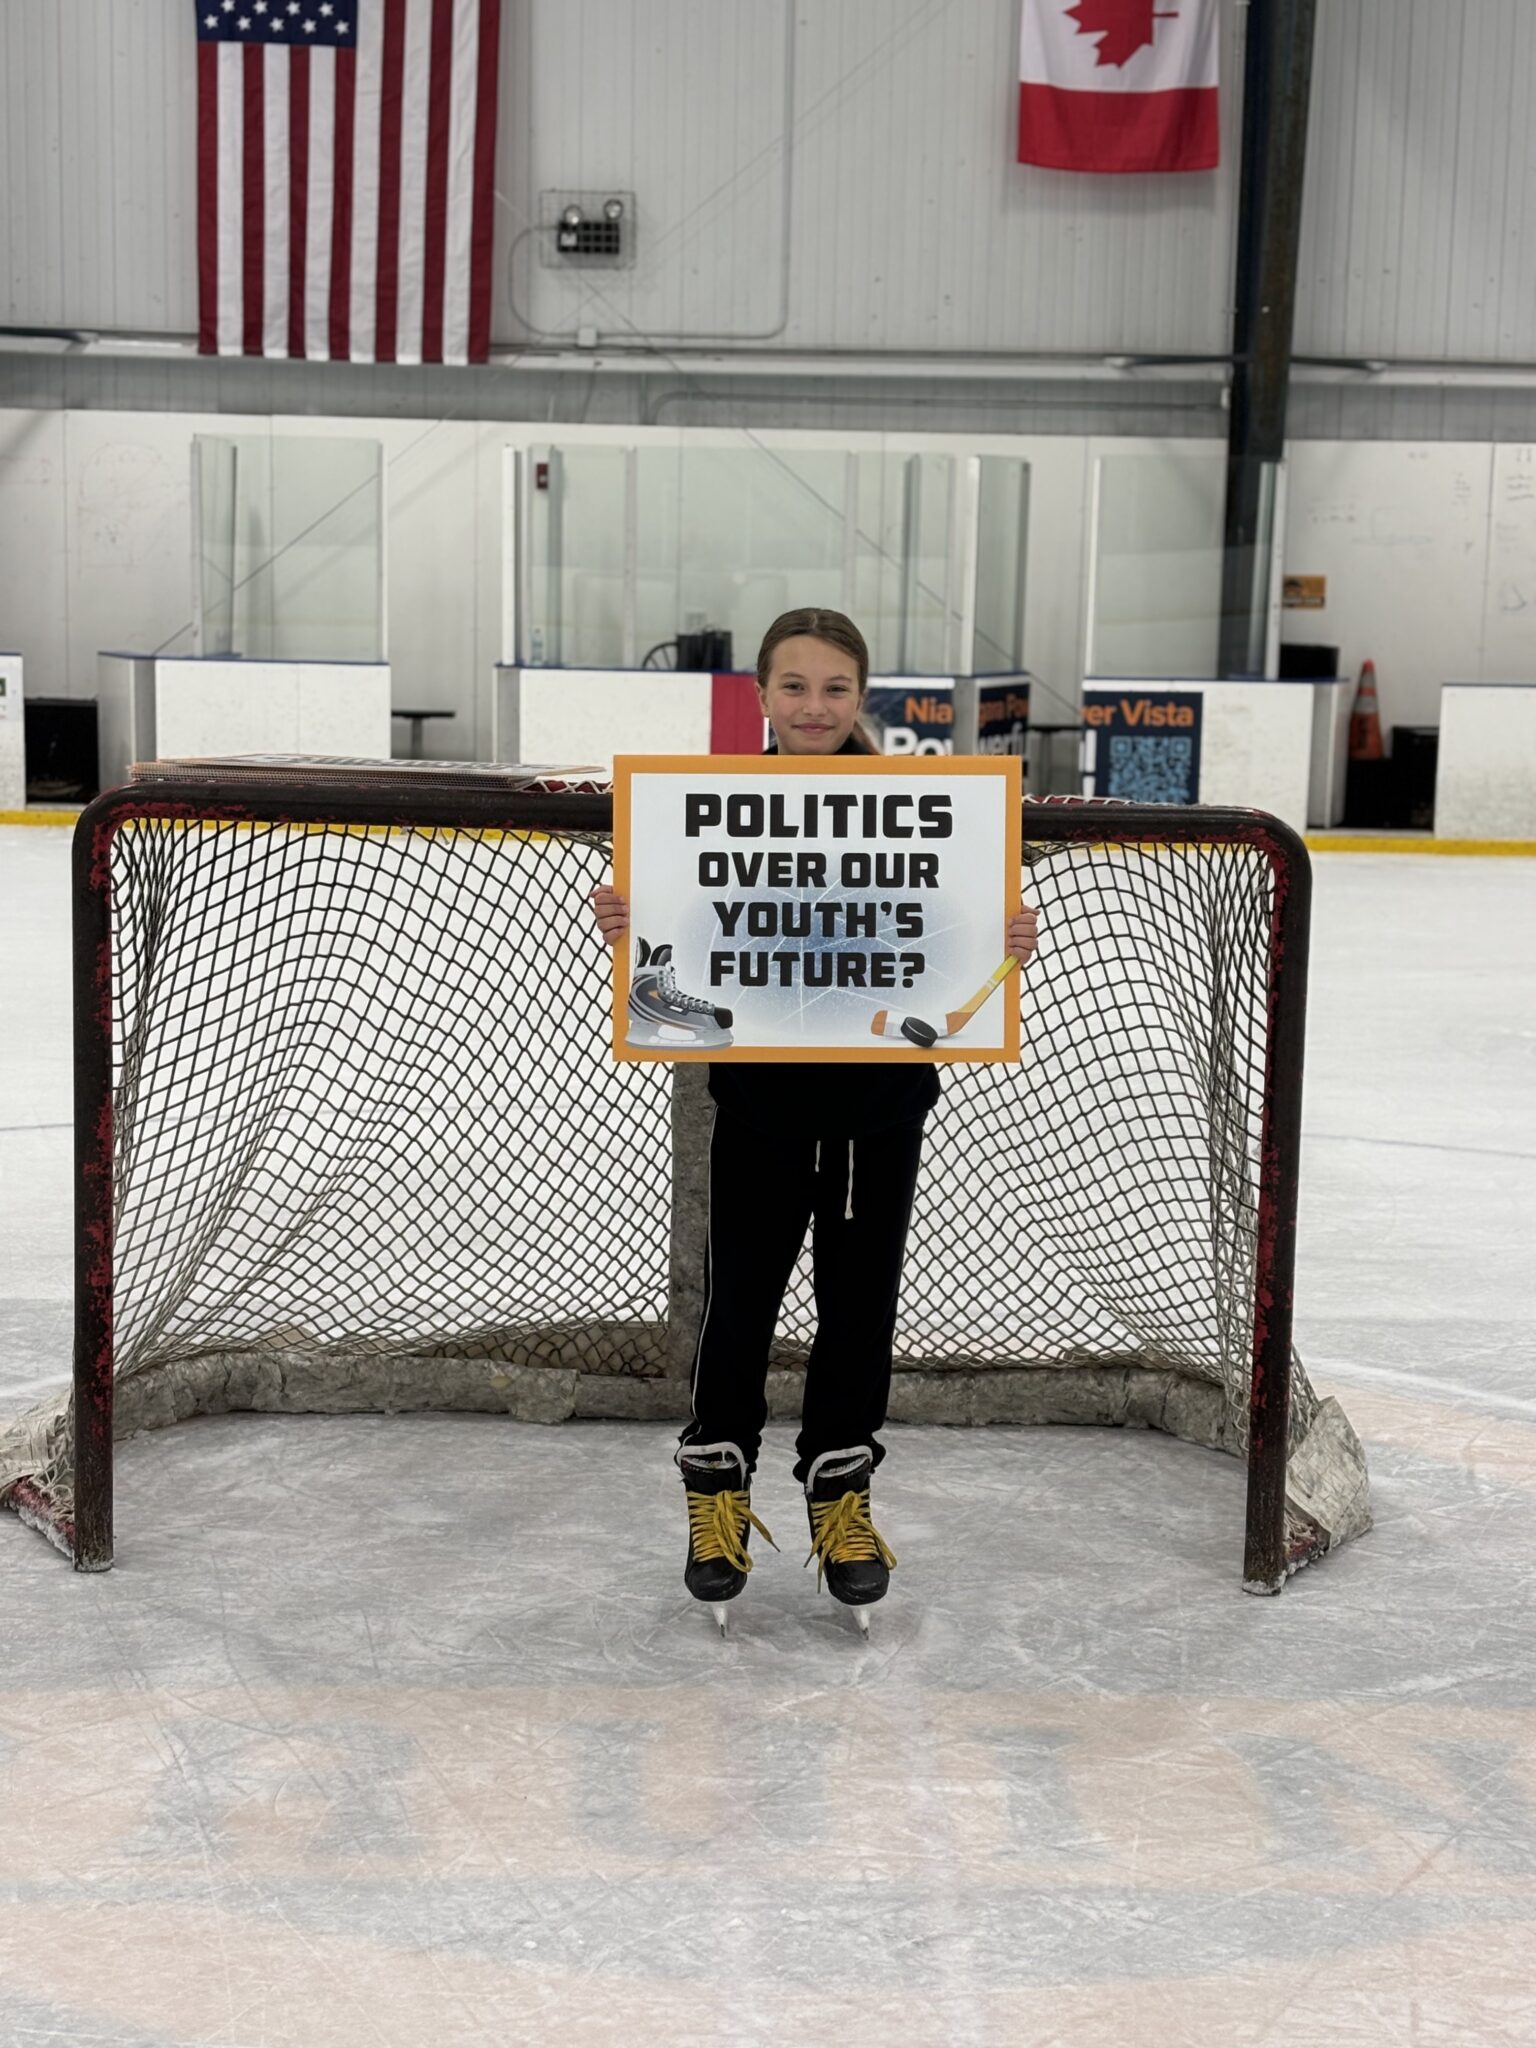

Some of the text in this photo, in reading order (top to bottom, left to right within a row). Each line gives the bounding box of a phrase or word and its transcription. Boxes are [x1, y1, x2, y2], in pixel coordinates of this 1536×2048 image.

[905, 696, 953, 723] Nia
[1121, 699, 1194, 727] Vista
[685, 793, 953, 839] POLITICS
[698, 851, 940, 889] OVER OUR
[712, 901, 924, 938] YOUTH'S
[710, 951, 926, 989] FUTURE?
